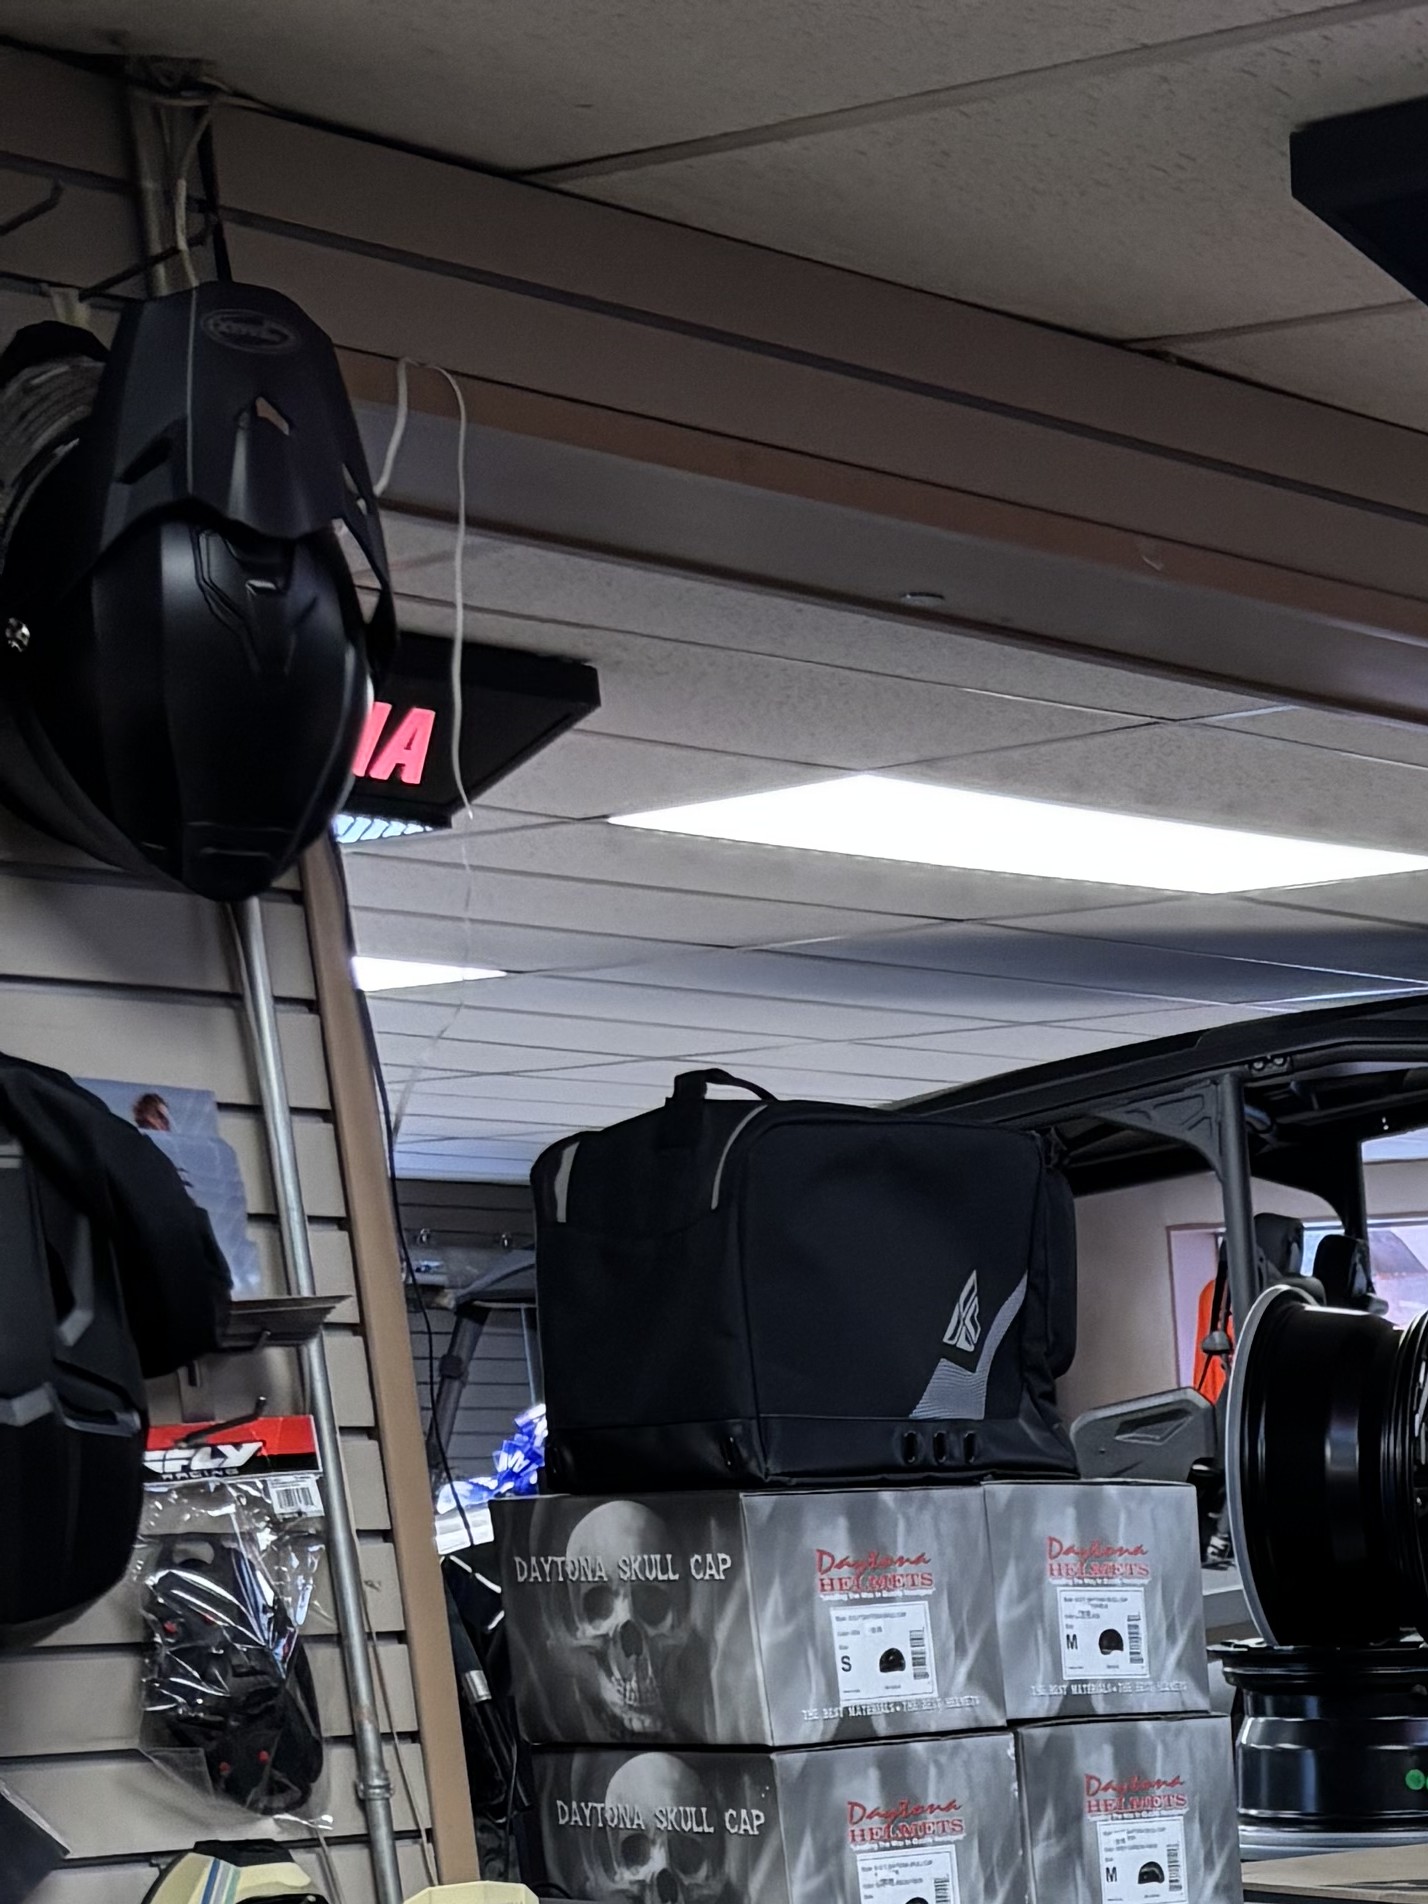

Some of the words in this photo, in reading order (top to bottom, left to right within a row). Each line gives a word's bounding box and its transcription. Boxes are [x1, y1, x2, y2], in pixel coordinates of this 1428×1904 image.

[143, 1441, 264, 1473] FLY
[514, 1556, 608, 1582] DAYTONA
[618, 1554, 679, 1581] SKULL
[690, 1553, 731, 1580] CAP
[1066, 1634, 1078, 1650] M
[841, 1655, 852, 1672] S
[557, 1800, 645, 1830] DAYTONA
[654, 1807, 714, 1833] SKULL
[725, 1809, 765, 1834] CAP
[1106, 1867, 1118, 1882] M
